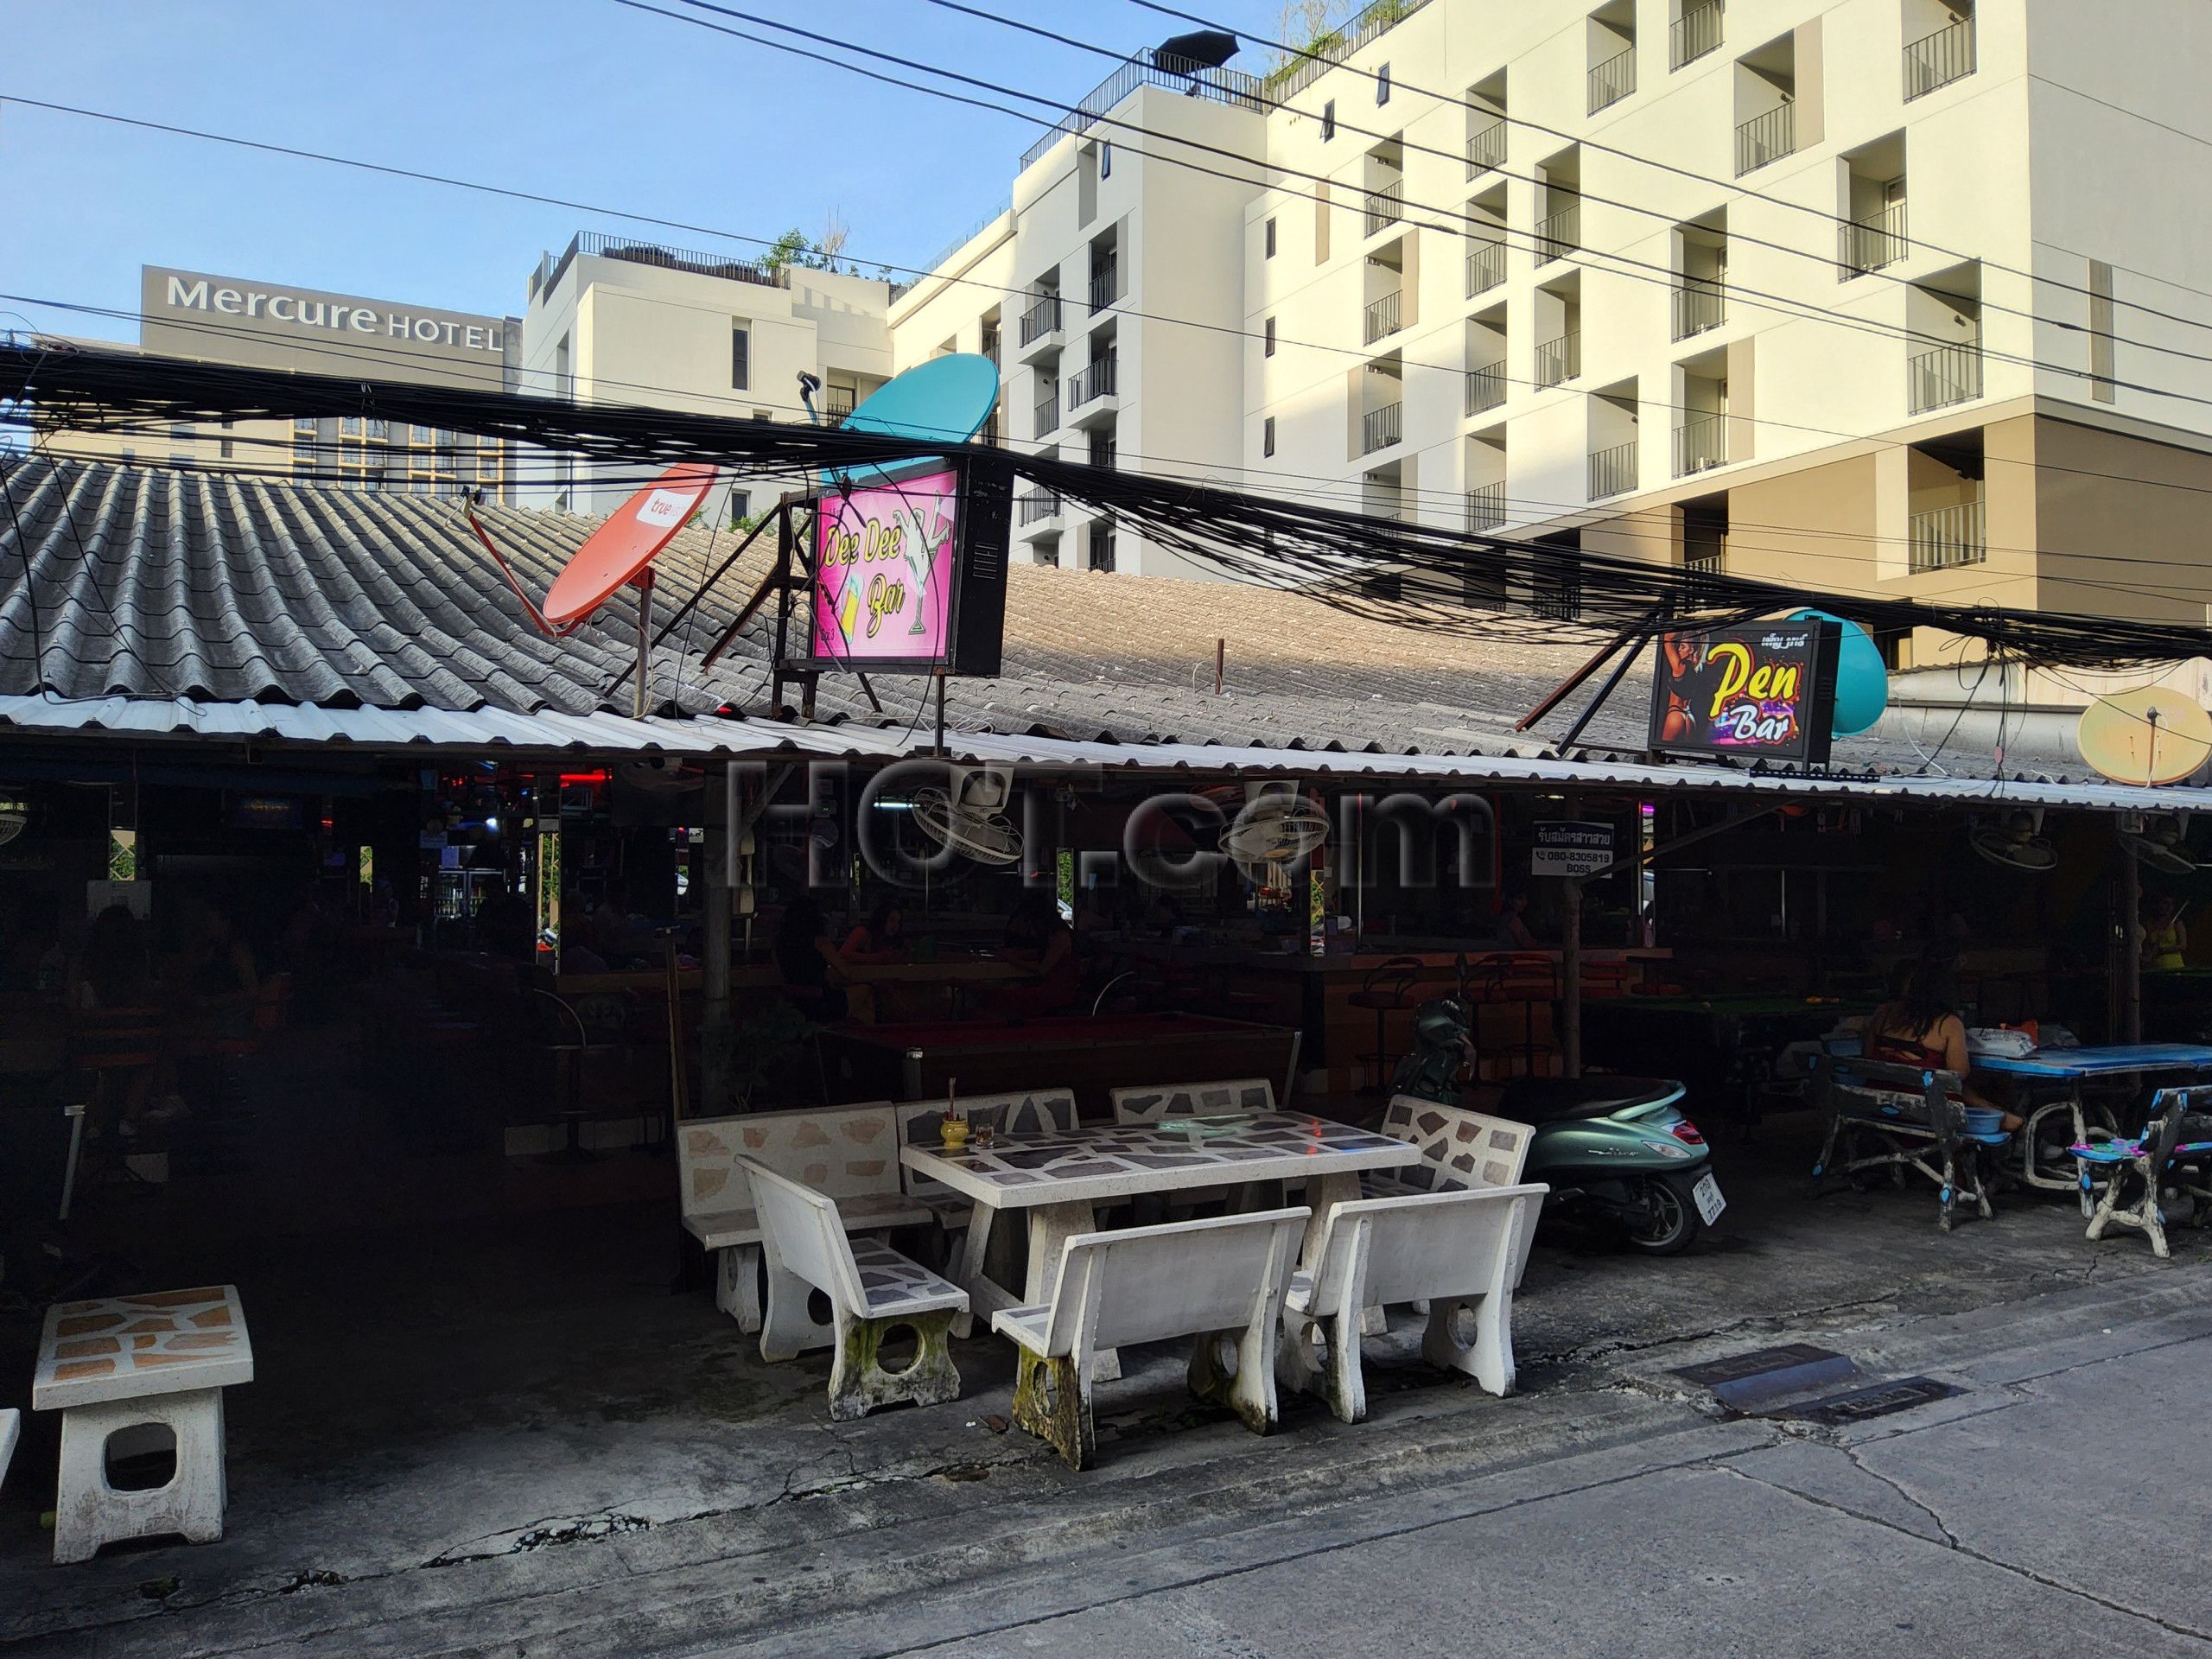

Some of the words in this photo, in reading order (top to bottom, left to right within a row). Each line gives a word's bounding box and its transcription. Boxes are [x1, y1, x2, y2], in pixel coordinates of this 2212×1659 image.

[167, 276, 378, 334] Mercure
[387, 314, 504, 352] HOTEL
[651, 498, 672, 516] true
[824, 526, 860, 567] Dee
[864, 517, 902, 563] Dee
[867, 573, 906, 638] Bar
[1707, 642, 1797, 718] Pen
[1729, 704, 1789, 741] Bar
[1547, 851, 1610, 863] 080-8305819
[1567, 864, 1591, 874] BOSS
